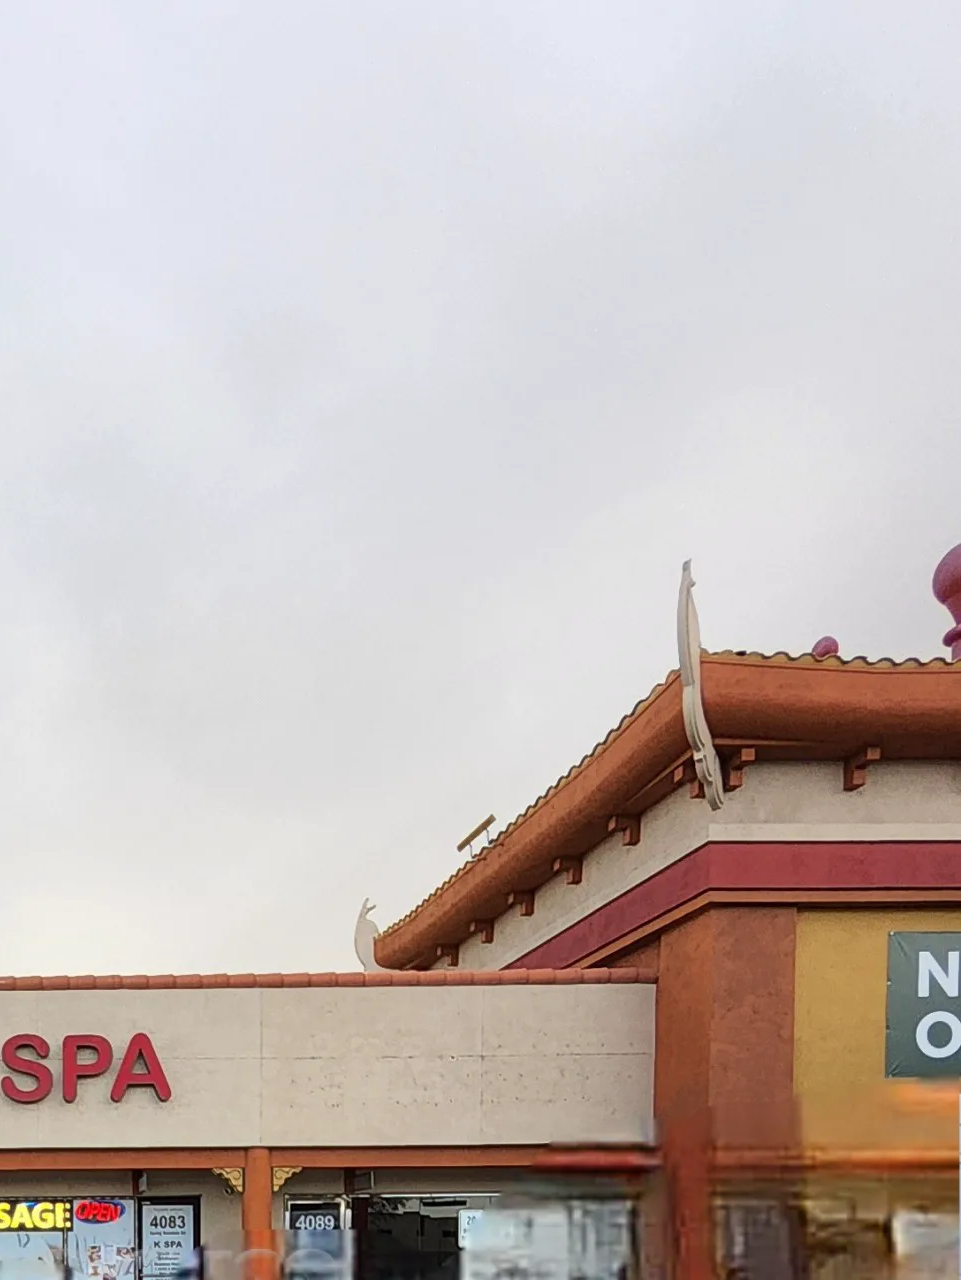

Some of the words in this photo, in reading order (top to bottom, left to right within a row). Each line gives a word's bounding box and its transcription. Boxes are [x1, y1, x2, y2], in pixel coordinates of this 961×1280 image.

[1, 1032, 172, 1104] SPA
[75, 1201, 121, 1223] OPEN
[149, 1215, 186, 1229] 4083
[295, 1214, 335, 1230] 4089
[163, 1240, 183, 1249] SPA
